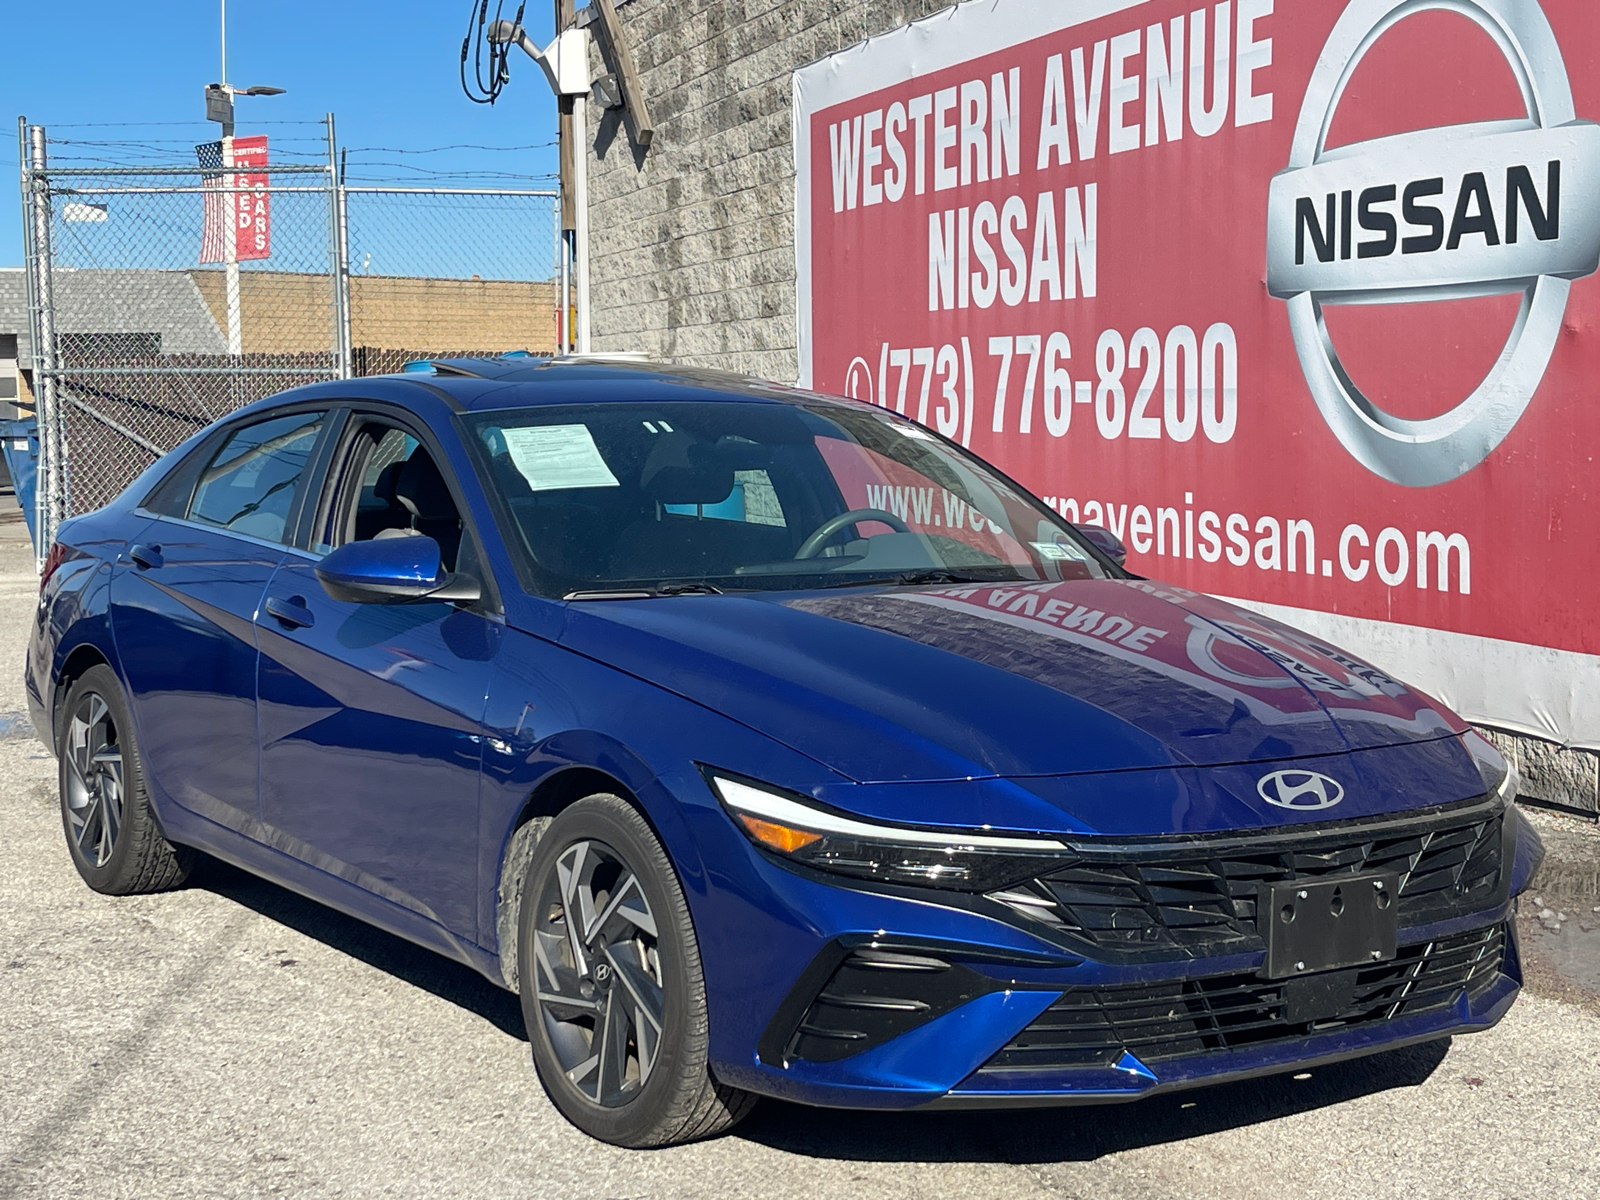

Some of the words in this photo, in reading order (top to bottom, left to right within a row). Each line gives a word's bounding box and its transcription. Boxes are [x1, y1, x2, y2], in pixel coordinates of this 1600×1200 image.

[233, 146, 268, 156] CERTIFIED
[829, 67, 1021, 213] WESTERN
[1037, 0, 1274, 171] AVENUE
[254, 181, 267, 250] CARS
[929, 182, 1097, 312] NISSAN
[1295, 160, 1560, 265] NISSAN
[878, 336, 974, 450] (773)
[988, 322, 1238, 444] 776-8200
